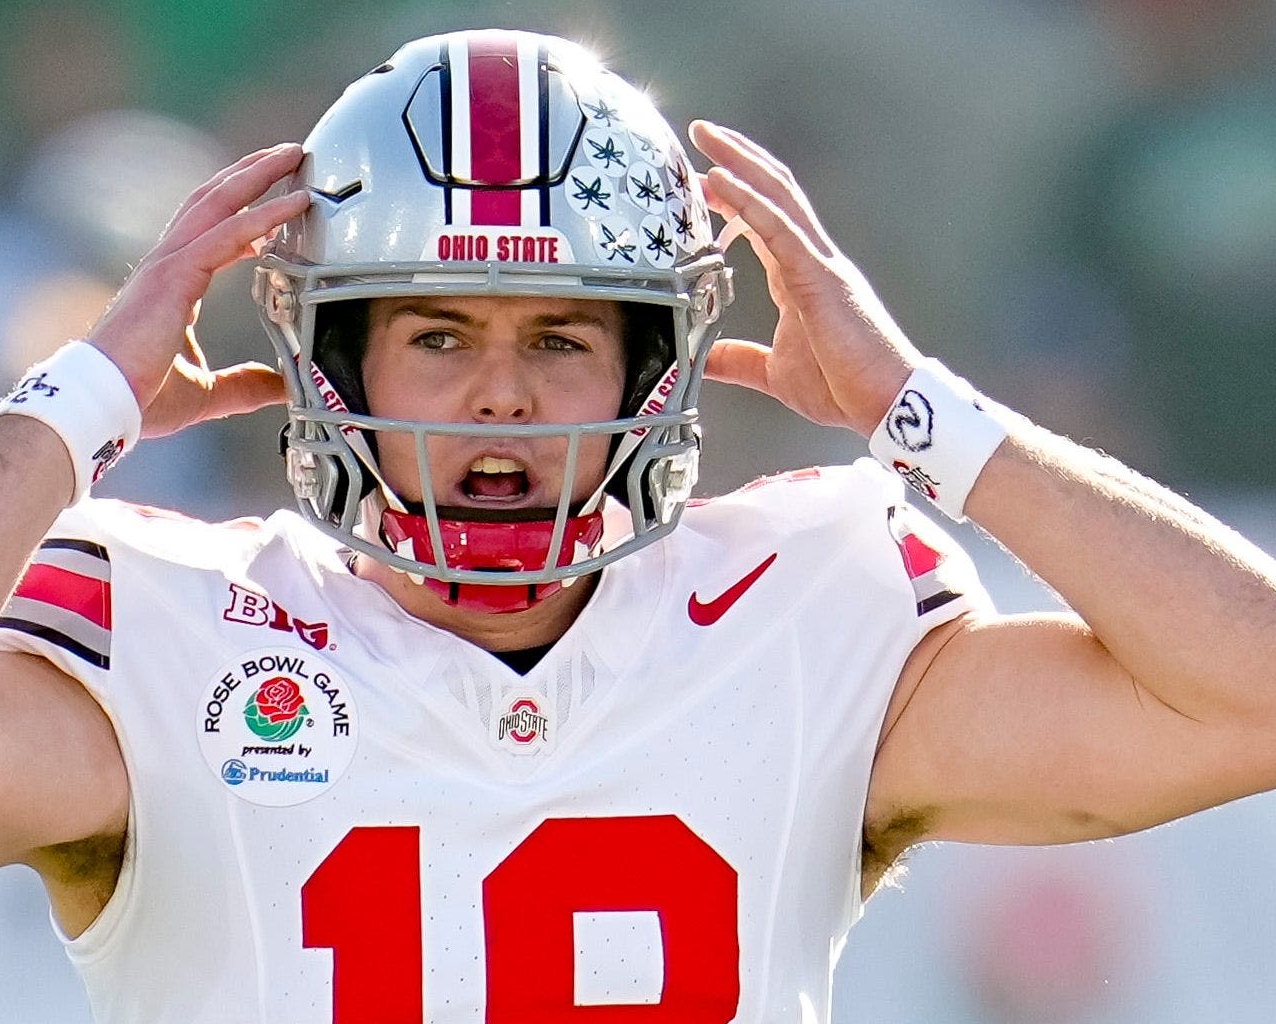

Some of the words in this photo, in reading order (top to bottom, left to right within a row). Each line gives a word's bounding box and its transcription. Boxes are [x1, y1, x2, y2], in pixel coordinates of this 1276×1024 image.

[438, 235, 488, 261] OHIO
[497, 235, 558, 263] STATE
[204, 672, 242, 733] ROSE
[241, 655, 309, 679] BOWL
[313, 673, 350, 737] GAME
[241, 744, 295, 757] presented
[298, 743, 312, 758] by
[248, 766, 329, 784] Prudential
